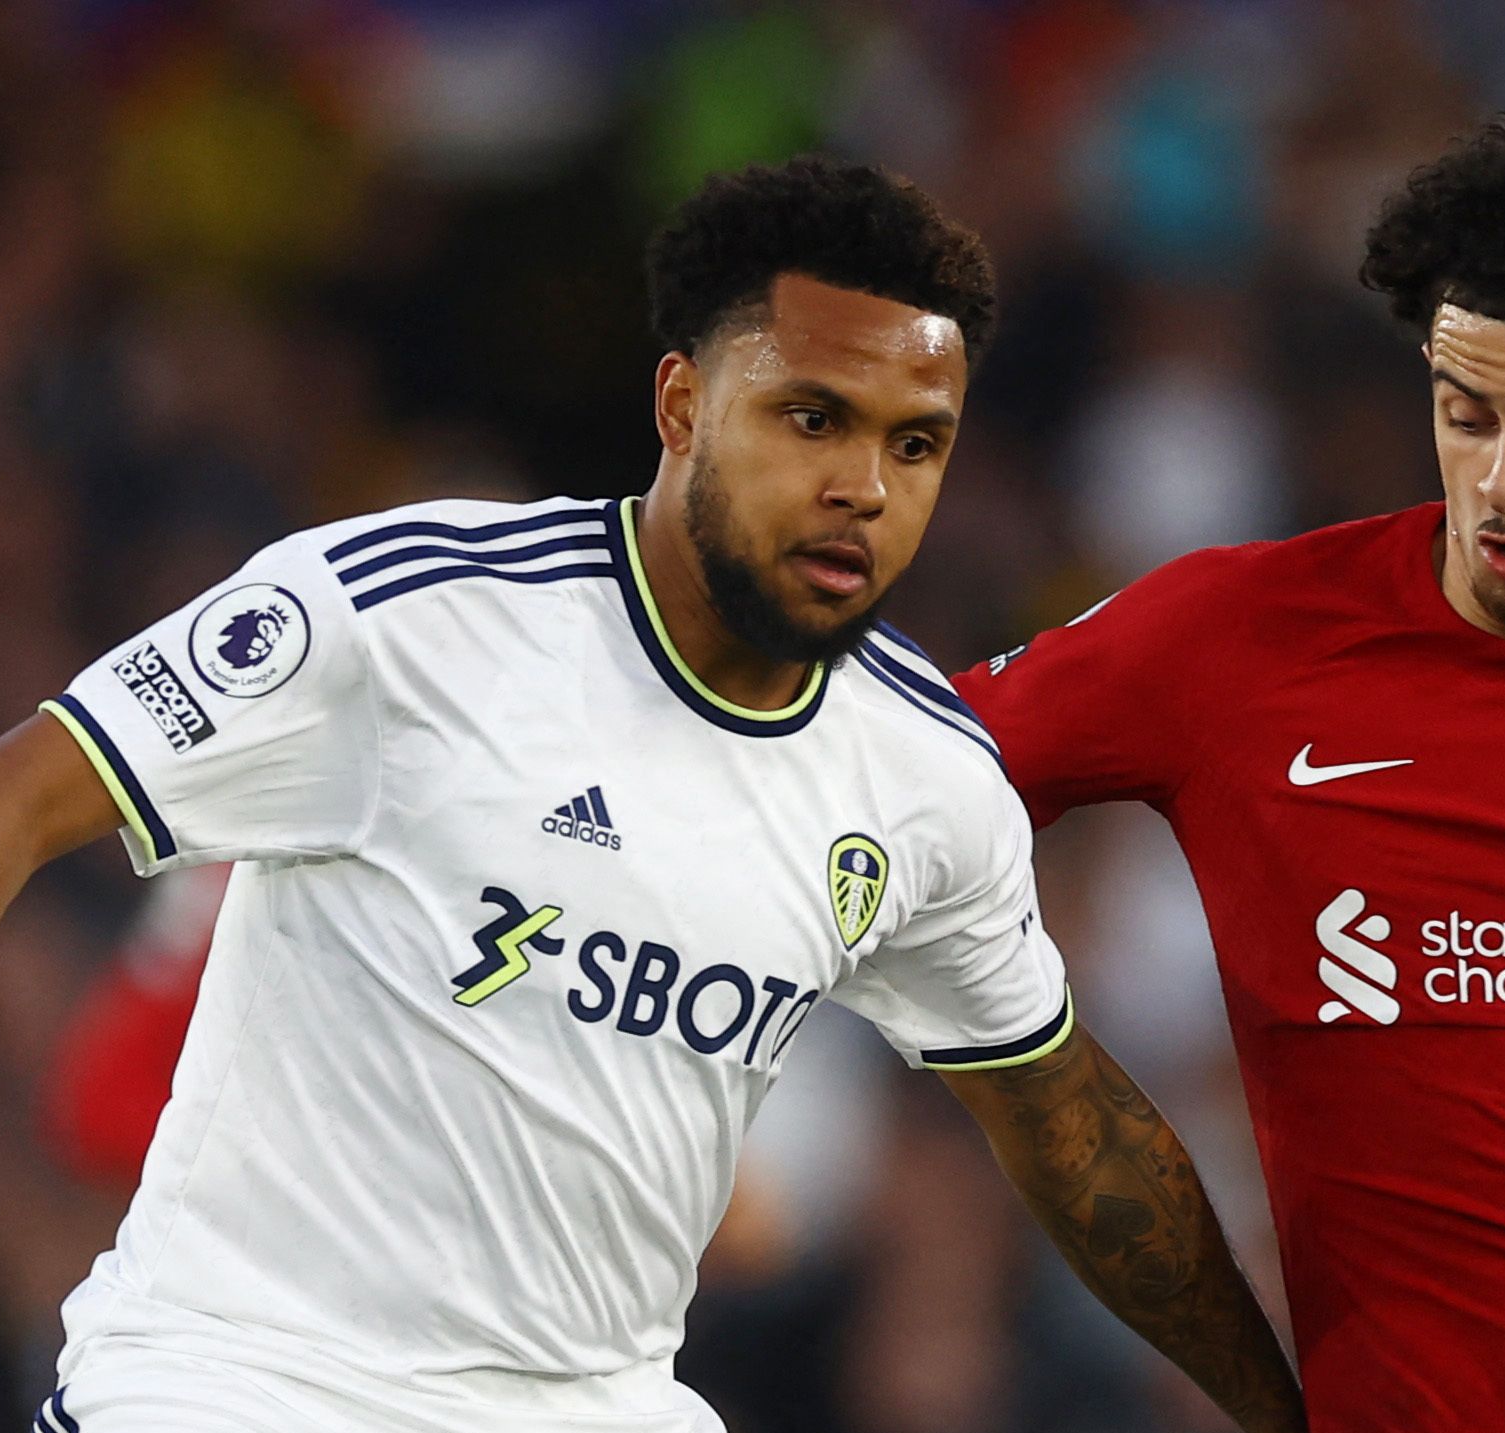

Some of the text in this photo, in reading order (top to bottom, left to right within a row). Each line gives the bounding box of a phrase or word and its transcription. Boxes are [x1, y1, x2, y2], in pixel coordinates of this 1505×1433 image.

[113, 654, 193, 754] for racism
[130, 642, 205, 733] No room
[206, 661, 277, 685] Premier League
[541, 816, 621, 851] adidas
